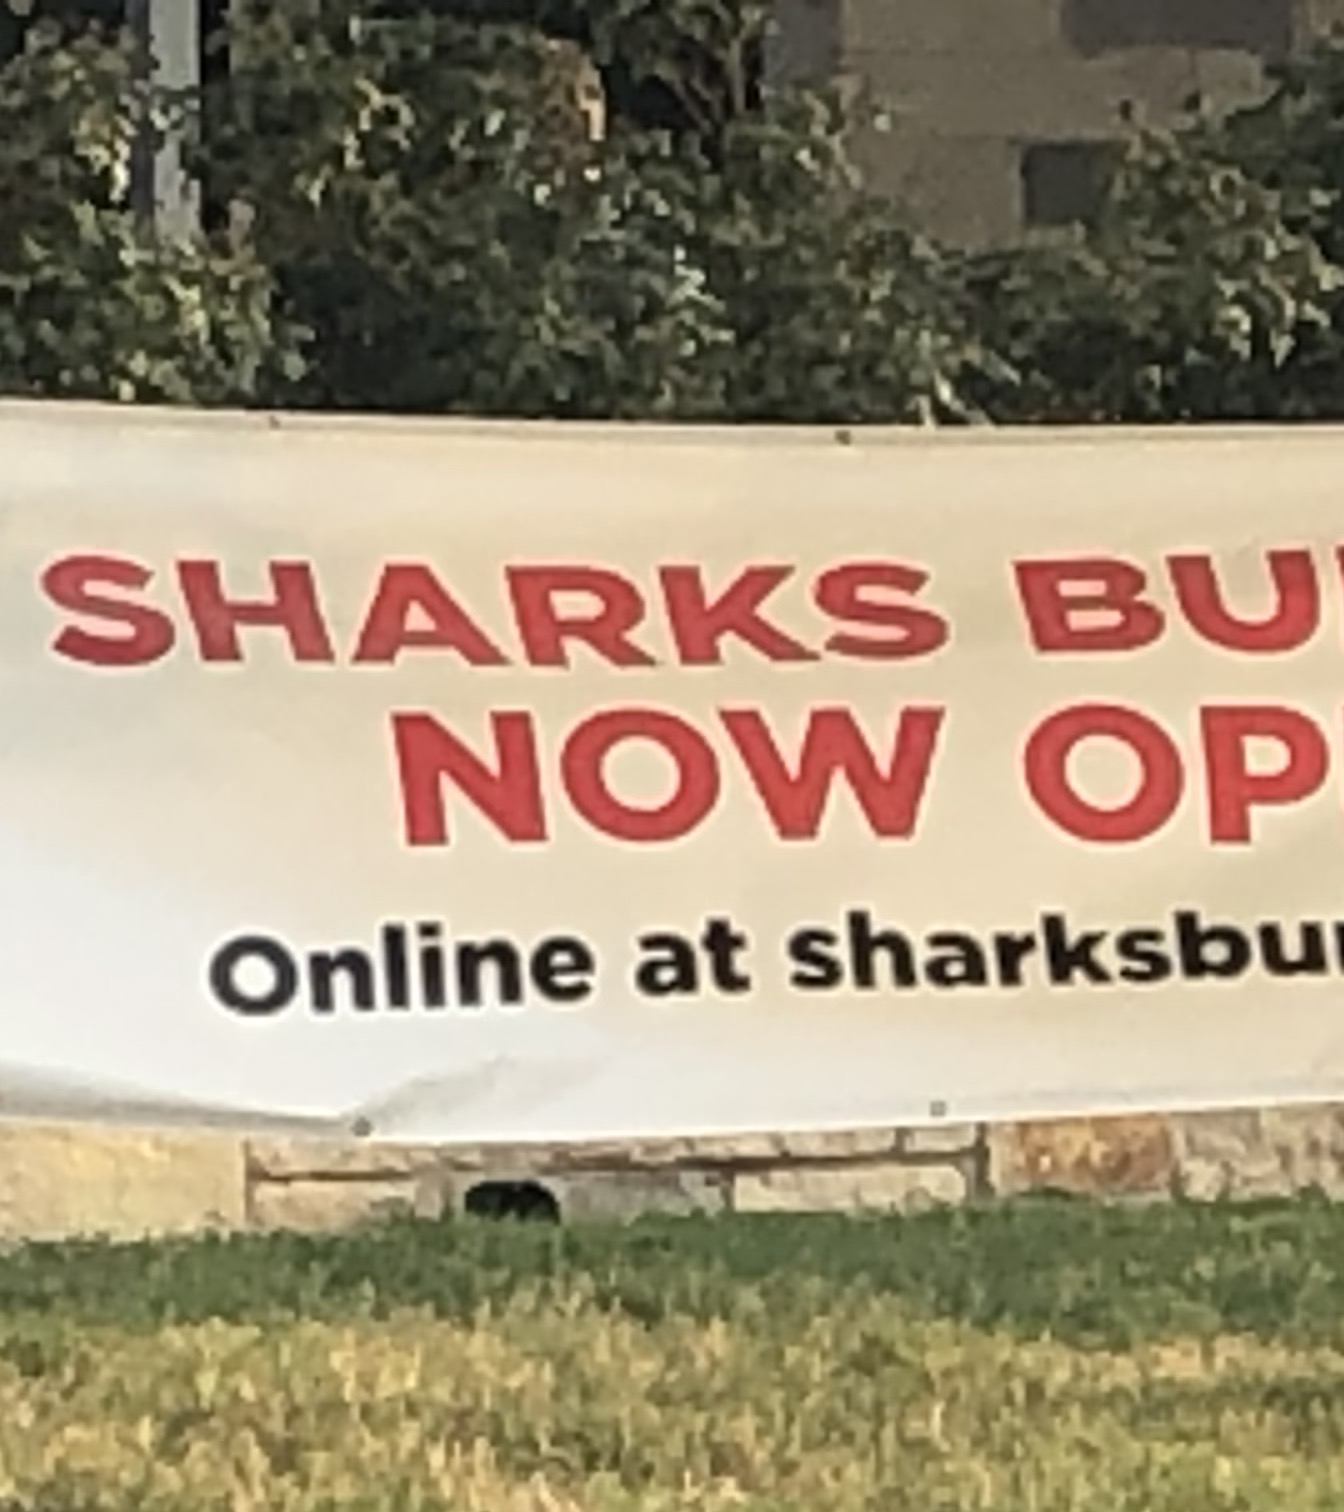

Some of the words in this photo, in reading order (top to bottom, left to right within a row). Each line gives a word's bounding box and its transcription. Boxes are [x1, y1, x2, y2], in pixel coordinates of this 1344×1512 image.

[40, 552, 950, 670] SHARKS
[390, 704, 946, 848] NOW
[208, 920, 596, 1018] Online
[633, 914, 752, 994] at
